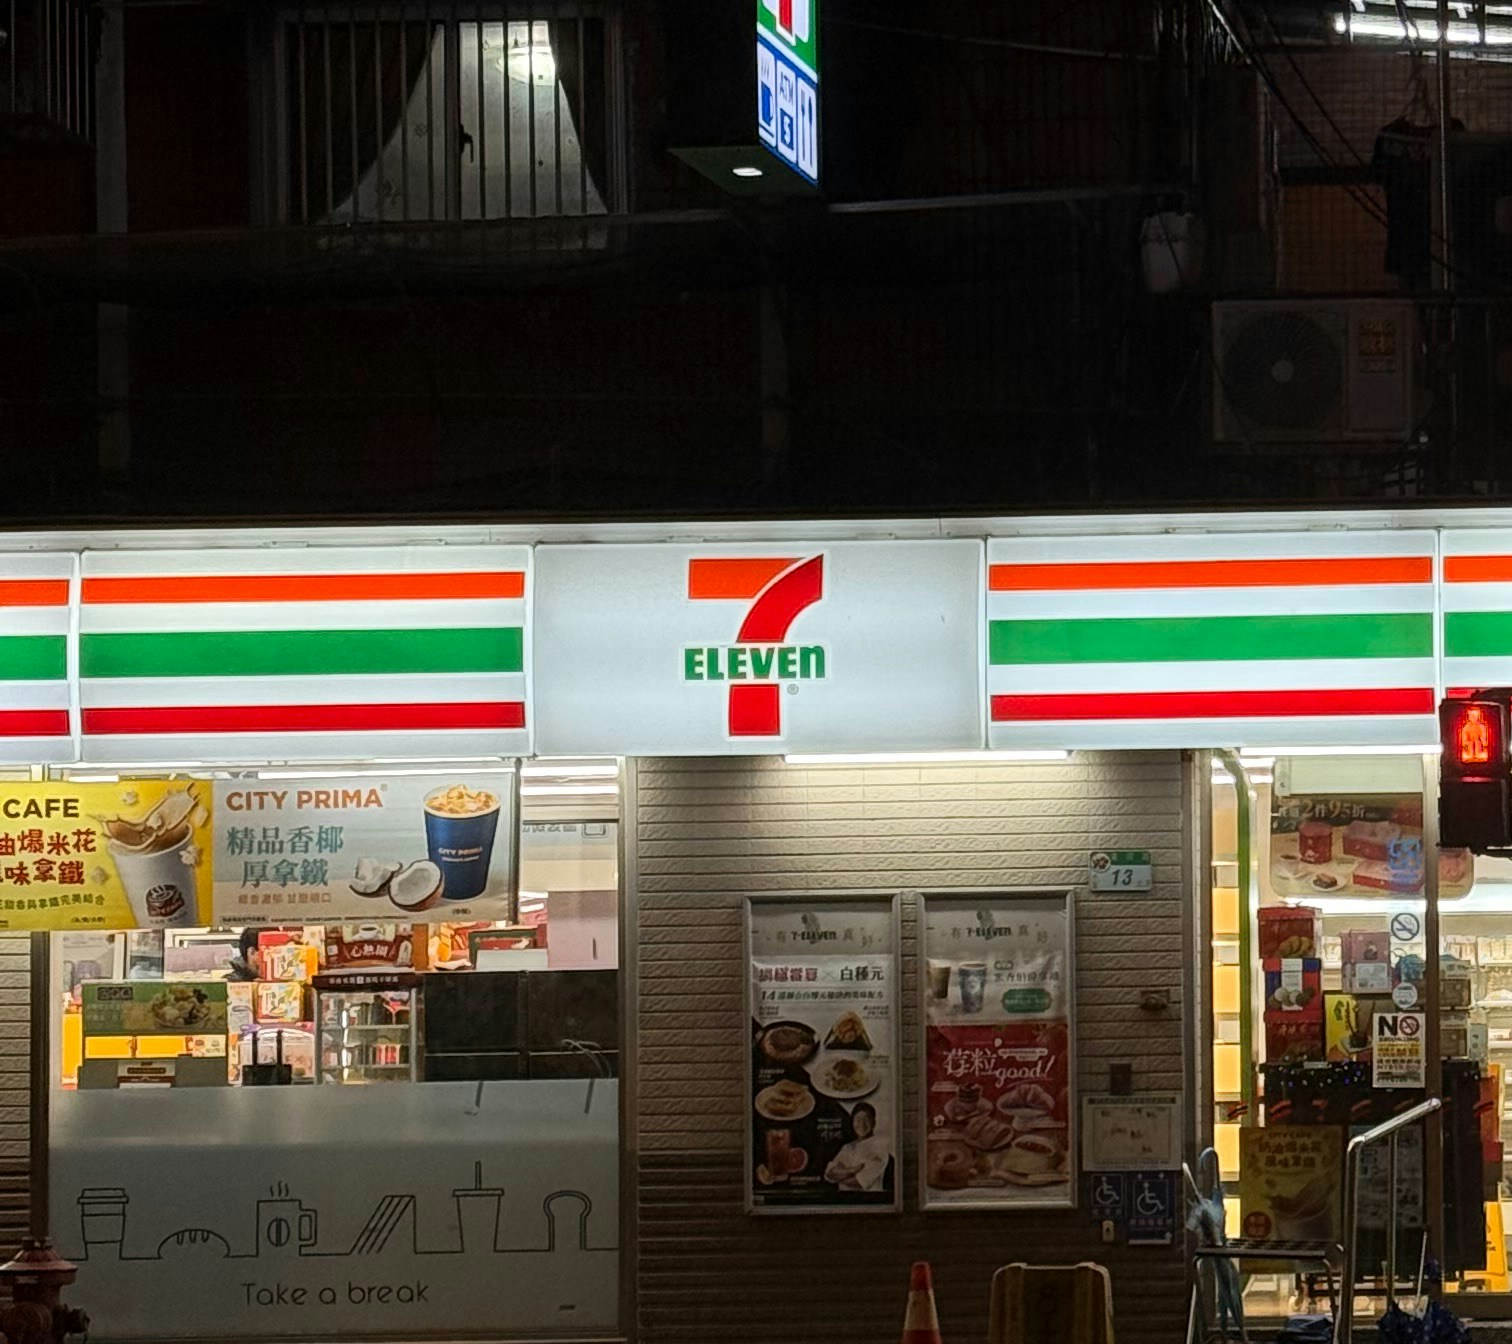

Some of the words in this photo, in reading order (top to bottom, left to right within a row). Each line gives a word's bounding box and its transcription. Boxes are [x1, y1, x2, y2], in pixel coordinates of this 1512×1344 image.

[779, 71, 794, 107] ATM
[688, 553, 824, 737] 7
[2, 798, 80, 819] CAFE
[226, 790, 288, 811] CITY
[296, 788, 384, 810] PRIMA
[226, 825, 345, 856] 精品香椰
[0, 858, 86, 886] 味拿鐵
[240, 859, 329, 888] 厚拿鐵
[1112, 868, 1134, 887] 13
[240, 1283, 308, 1306] Take
[318, 1285, 338, 1306] a
[348, 1281, 430, 1305] break
